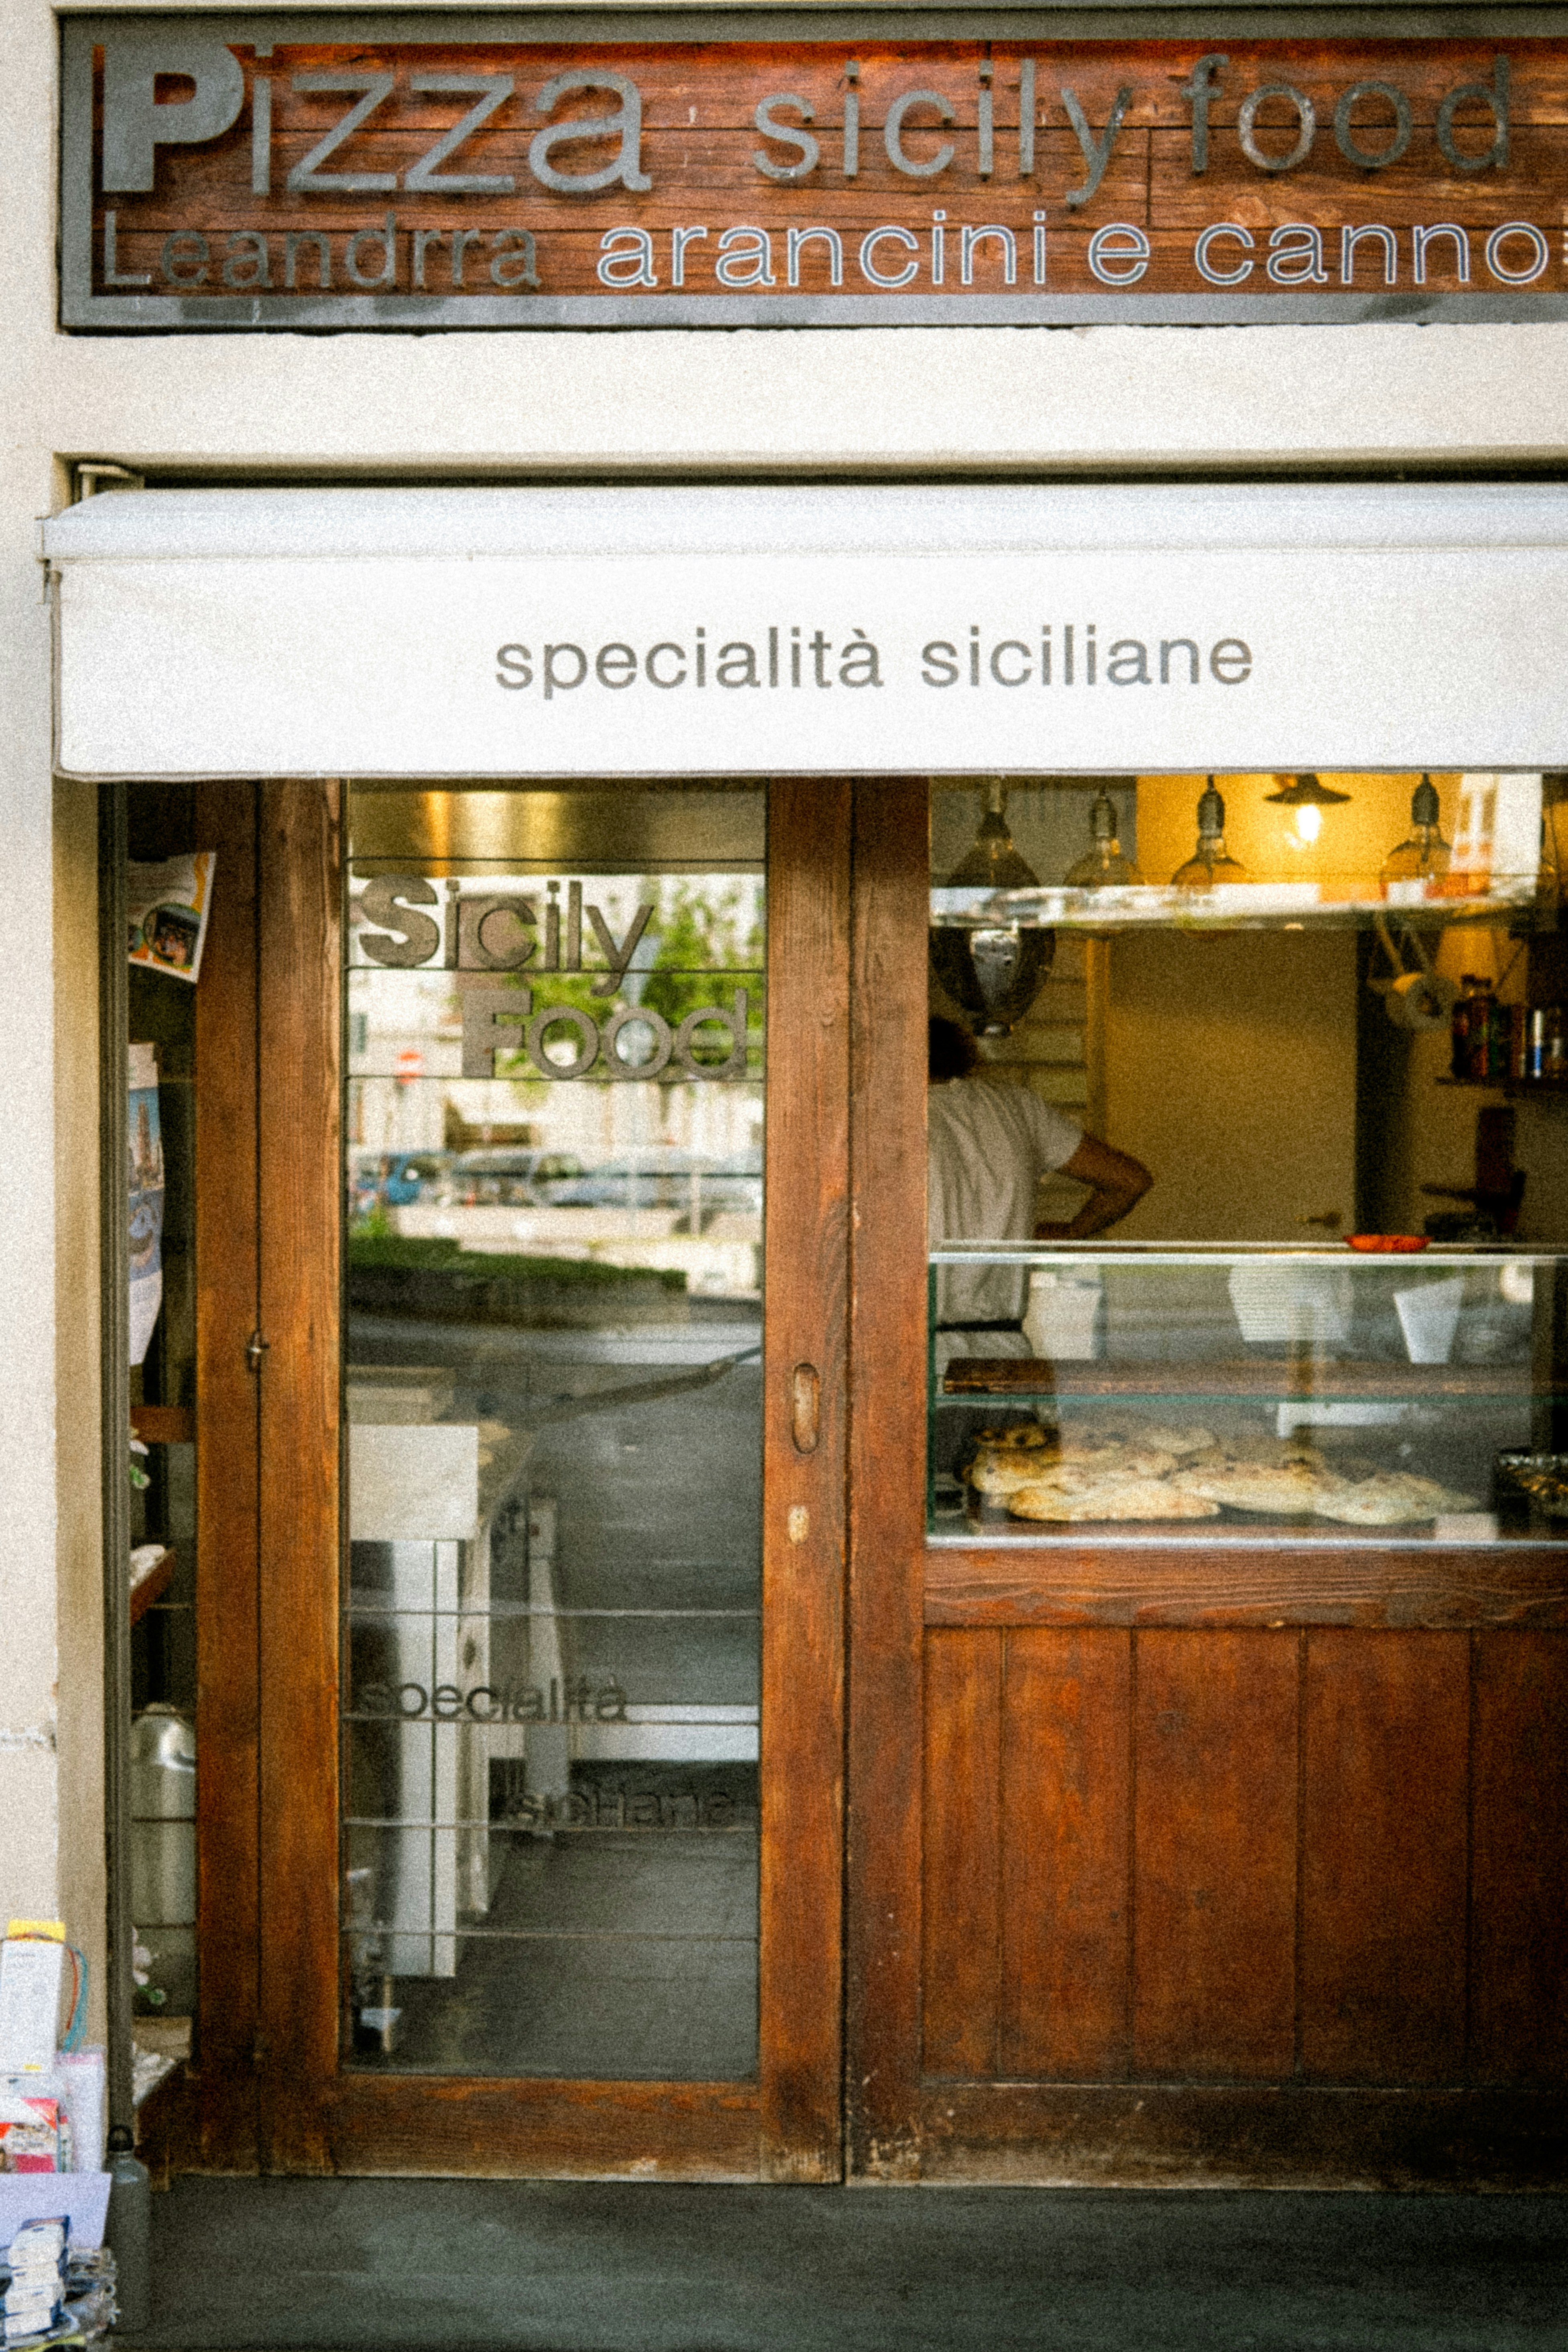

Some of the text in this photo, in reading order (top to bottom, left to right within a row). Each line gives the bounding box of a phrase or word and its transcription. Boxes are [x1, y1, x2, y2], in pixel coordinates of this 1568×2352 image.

[103, 42, 1510, 206] Pizza sicily food
[104, 211, 541, 287] Leandrra
[596, 210, 1046, 286] arancini
[1088, 223, 1150, 286] e
[496, 623, 1253, 700] specialità siciliane
[359, 873, 655, 997] Sicily
[462, 988, 748, 1079] Food
